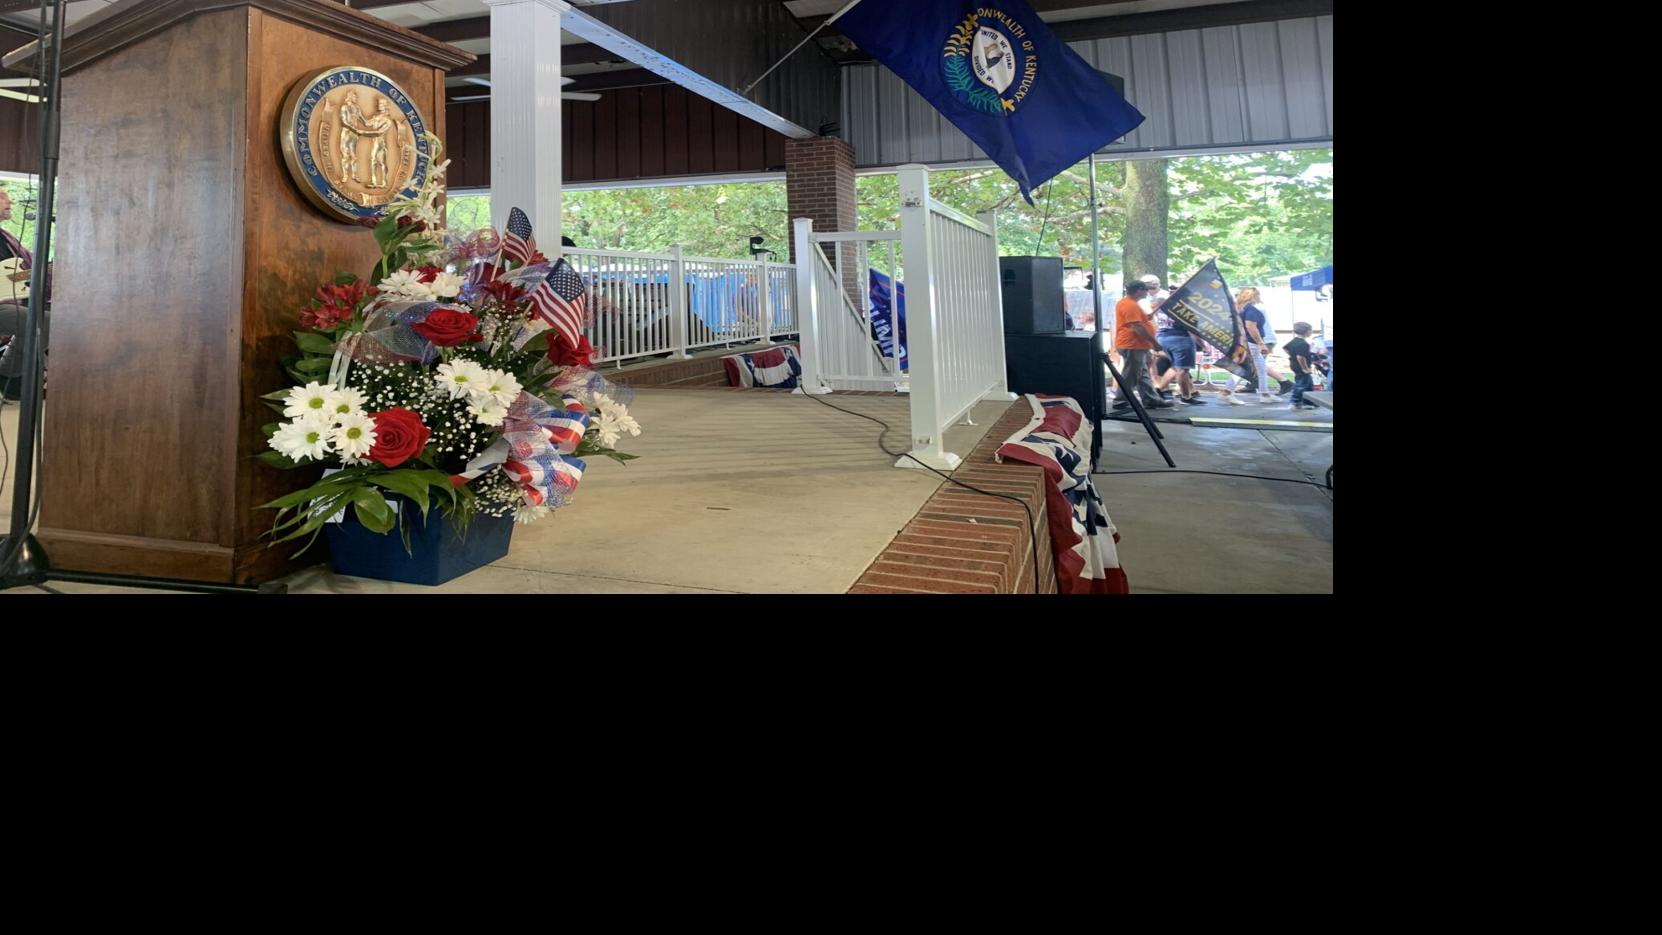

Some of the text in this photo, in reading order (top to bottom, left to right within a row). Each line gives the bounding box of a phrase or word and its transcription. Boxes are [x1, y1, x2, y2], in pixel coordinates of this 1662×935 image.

[1023, 41, 1034, 51] OF
[1014, 55, 1036, 102] KENTUCKY
[297, 73, 382, 177] COMMONWEALTH
[389, 89, 406, 105] OF
[1172, 303, 1198, 323] TAKE
[1187, 292, 1232, 319] 2024
